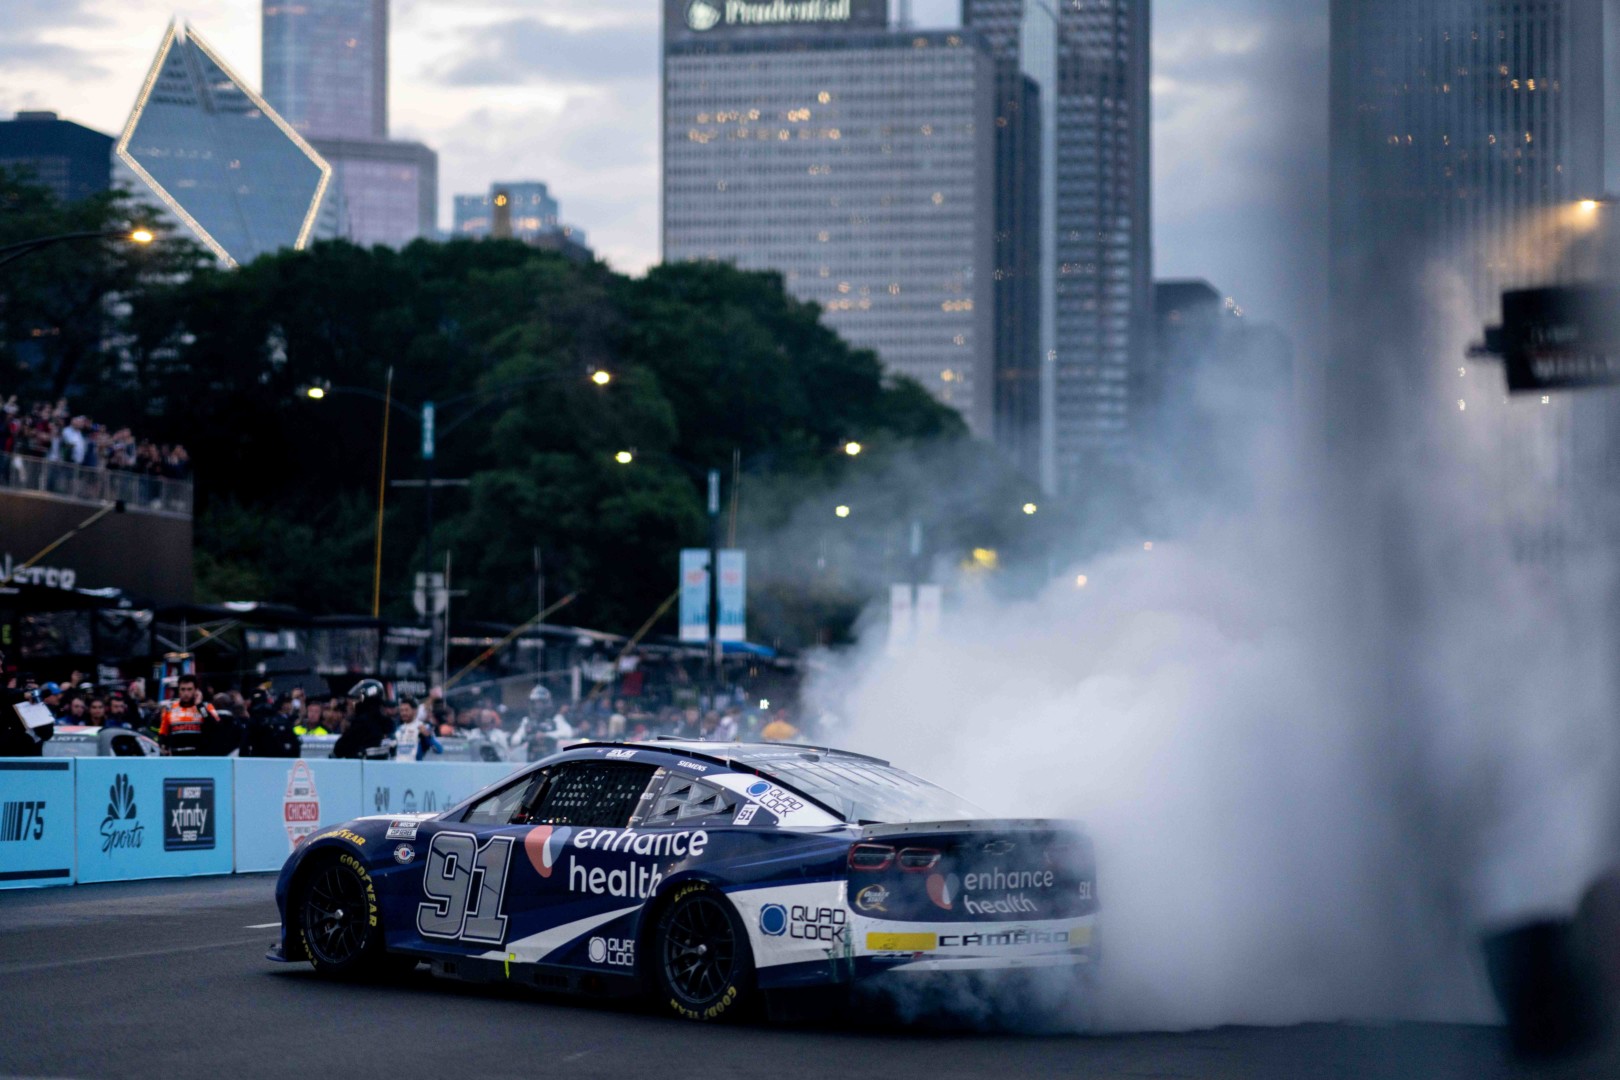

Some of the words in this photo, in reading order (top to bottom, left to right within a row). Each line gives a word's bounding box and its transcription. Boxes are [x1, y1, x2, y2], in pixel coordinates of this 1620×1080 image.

[725, 0, 850, 24] Prudential
[677, 760, 708, 772] SIEMENS
[287, 803, 316, 820] CHICAGO
[759, 793, 794, 818] LOCK
[768, 788, 804, 812] QUAD
[23, 801, 46, 841] 75
[172, 801, 207, 835] xfinity
[738, 810, 754, 820] 91
[100, 814, 144, 858] Sports
[573, 827, 709, 856] enhance
[416, 831, 515, 944] 91
[569, 854, 663, 899] health
[963, 867, 1054, 891] enhance
[340, 854, 378, 927] GOODYEAR
[674, 884, 706, 902] EAGLE
[1079, 881, 1092, 900] 91
[791, 905, 846, 925] QUAD
[963, 893, 1038, 914] health
[607, 937, 635, 952] QUA
[790, 923, 845, 943] LOCK
[939, 931, 1069, 947] CAMARO
